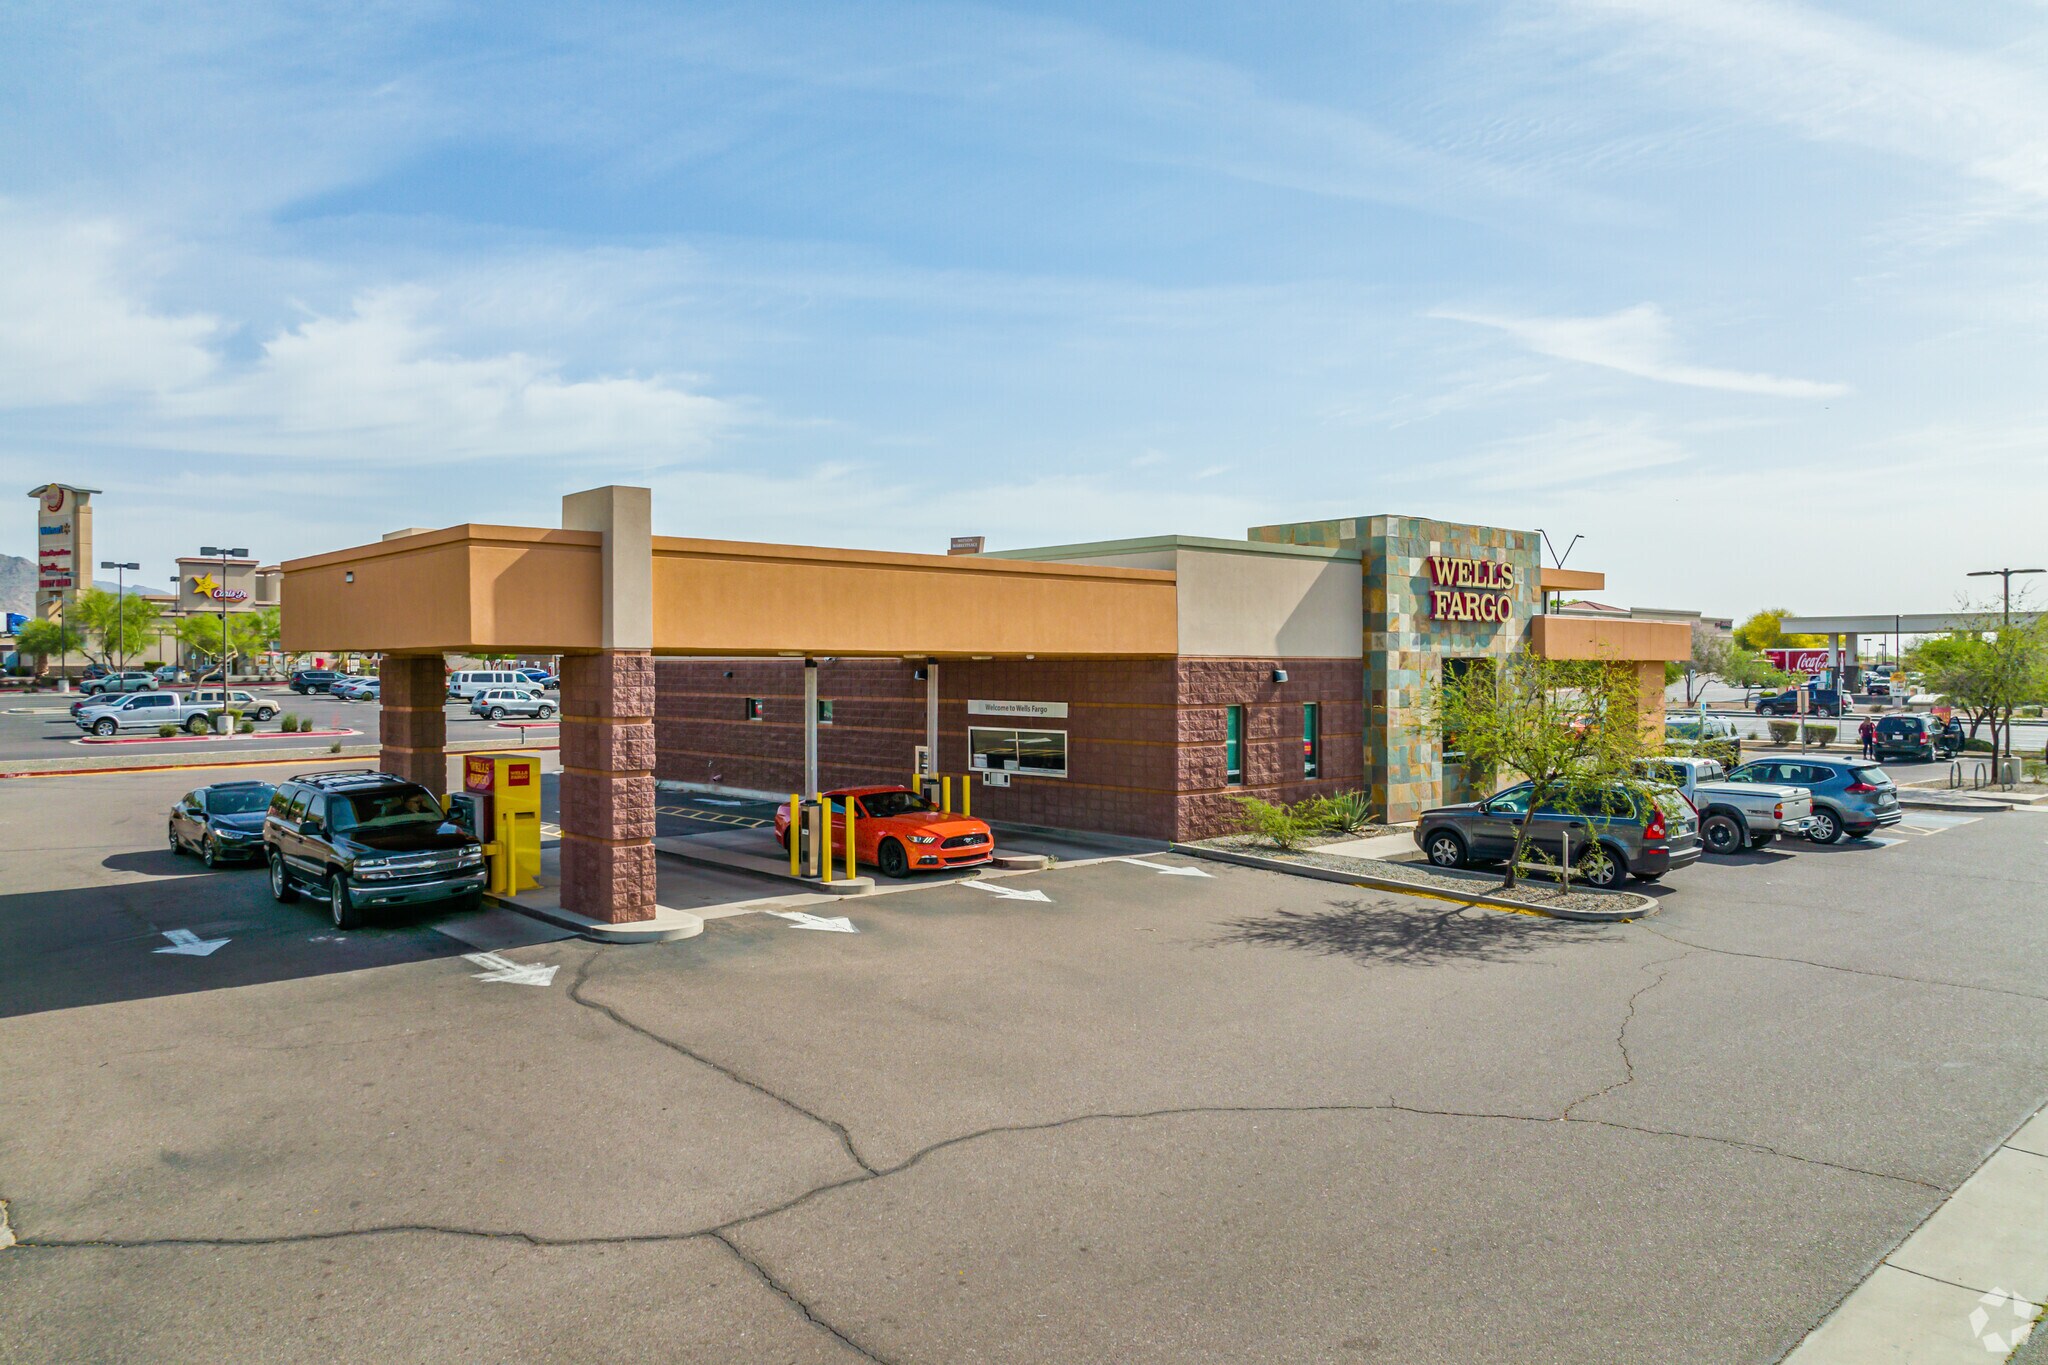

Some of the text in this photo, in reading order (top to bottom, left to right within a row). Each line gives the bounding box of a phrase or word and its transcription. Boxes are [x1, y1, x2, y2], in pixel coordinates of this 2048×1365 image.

[1427, 556, 1514, 590] WELLS
[1430, 591, 1513, 623] FARGO
[985, 703, 1009, 712] Welcome
[1016, 704, 1031, 713] Wells
[1031, 705, 1048, 715] Fargo
[469, 761, 490, 774] WELLS
[470, 773, 490, 785] FARGO
